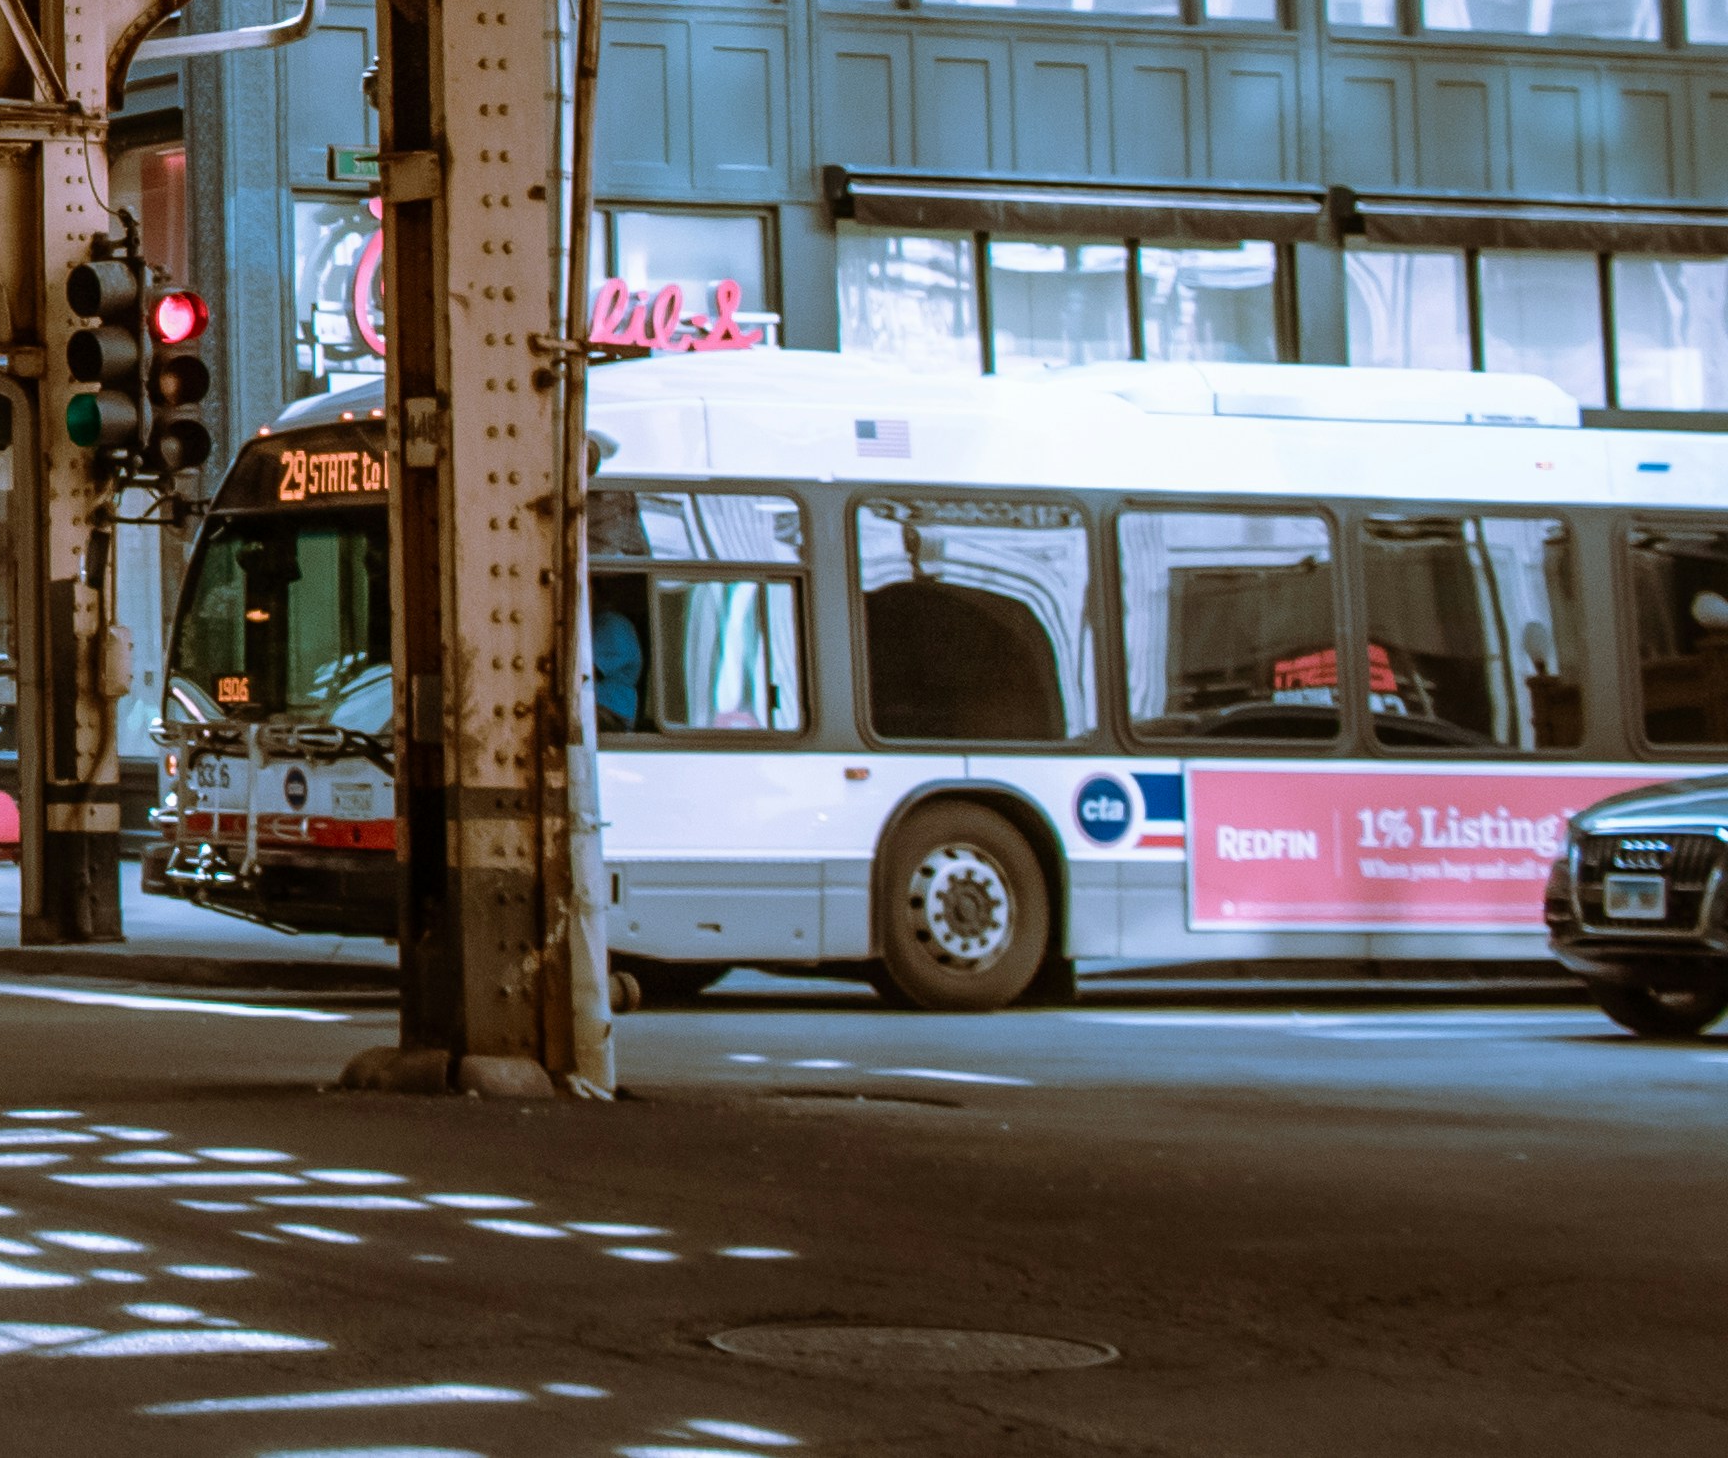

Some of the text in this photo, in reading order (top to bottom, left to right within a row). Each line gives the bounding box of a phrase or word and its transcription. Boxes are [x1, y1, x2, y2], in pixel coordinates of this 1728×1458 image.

[279, 450, 307, 501] 29
[308, 452, 359, 494] STATE
[362, 451, 382, 491] to
[1082, 795, 1124, 821] cta
[1216, 824, 1319, 862] REDFIN
[1356, 805, 1414, 850] 1%
[1419, 806, 1560, 857] Listing
